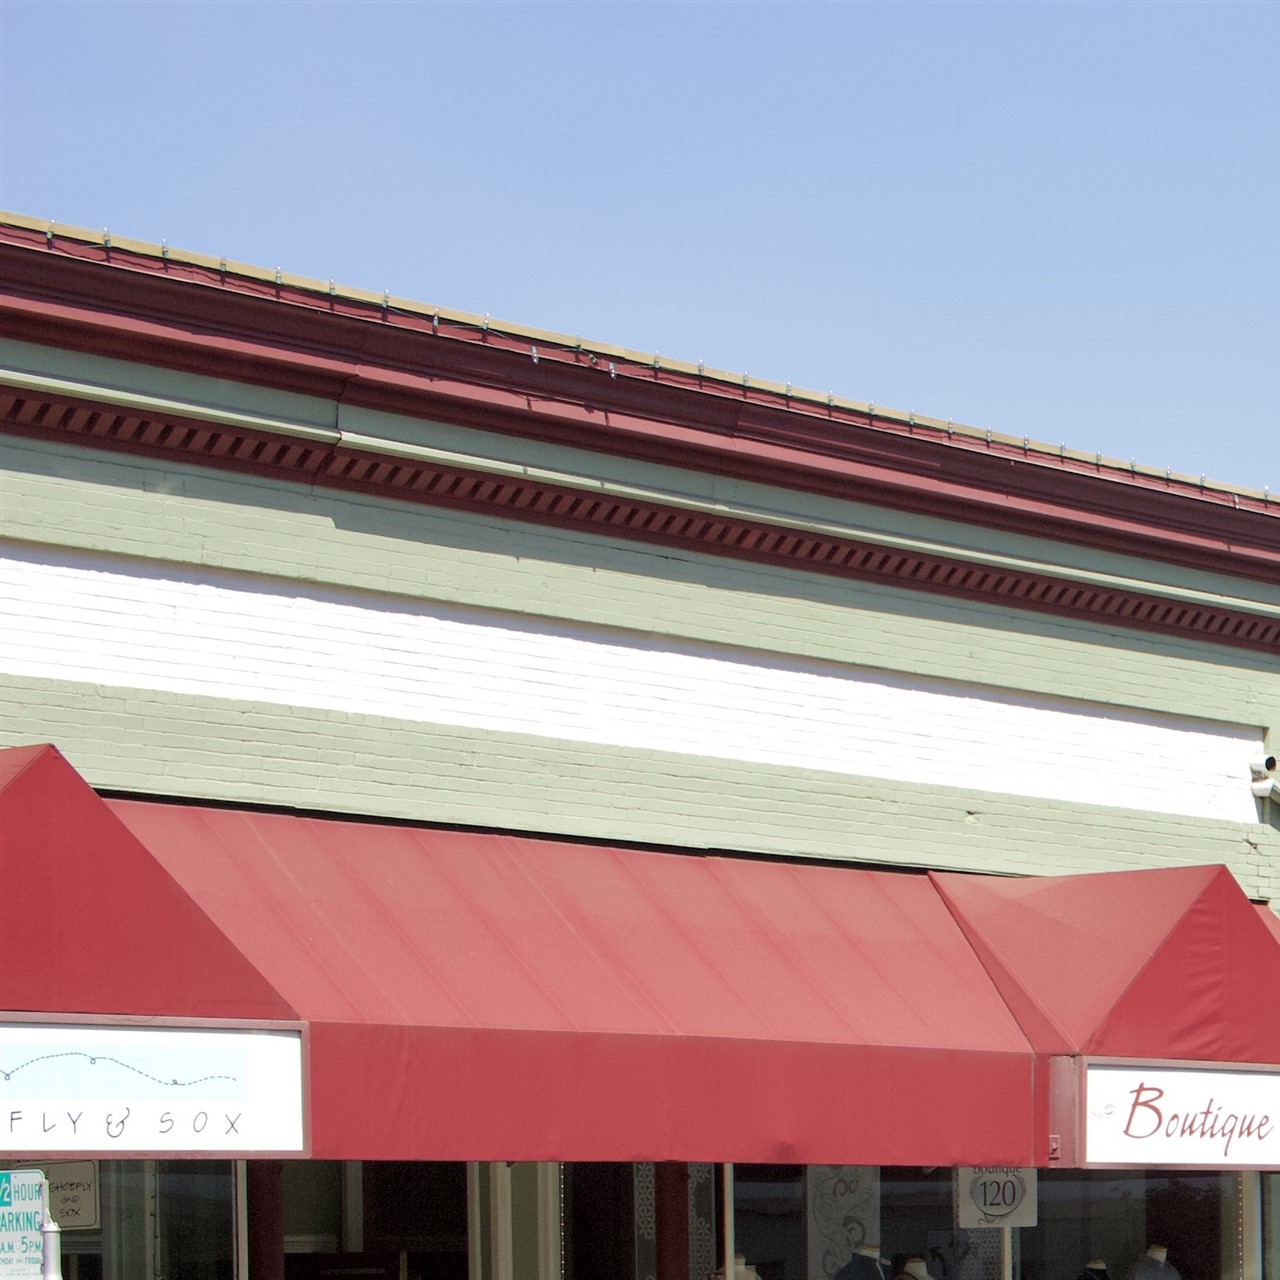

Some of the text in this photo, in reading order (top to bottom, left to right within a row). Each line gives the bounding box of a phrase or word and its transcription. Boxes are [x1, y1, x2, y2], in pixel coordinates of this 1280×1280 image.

[158, 1111, 242, 1135] SOX
[1122, 1081, 1275, 1157] Boutique
[979, 1180, 1016, 1207] 120
[0, 1210, 41, 1232] ARKING
[59, 1208, 81, 1218] SOX
